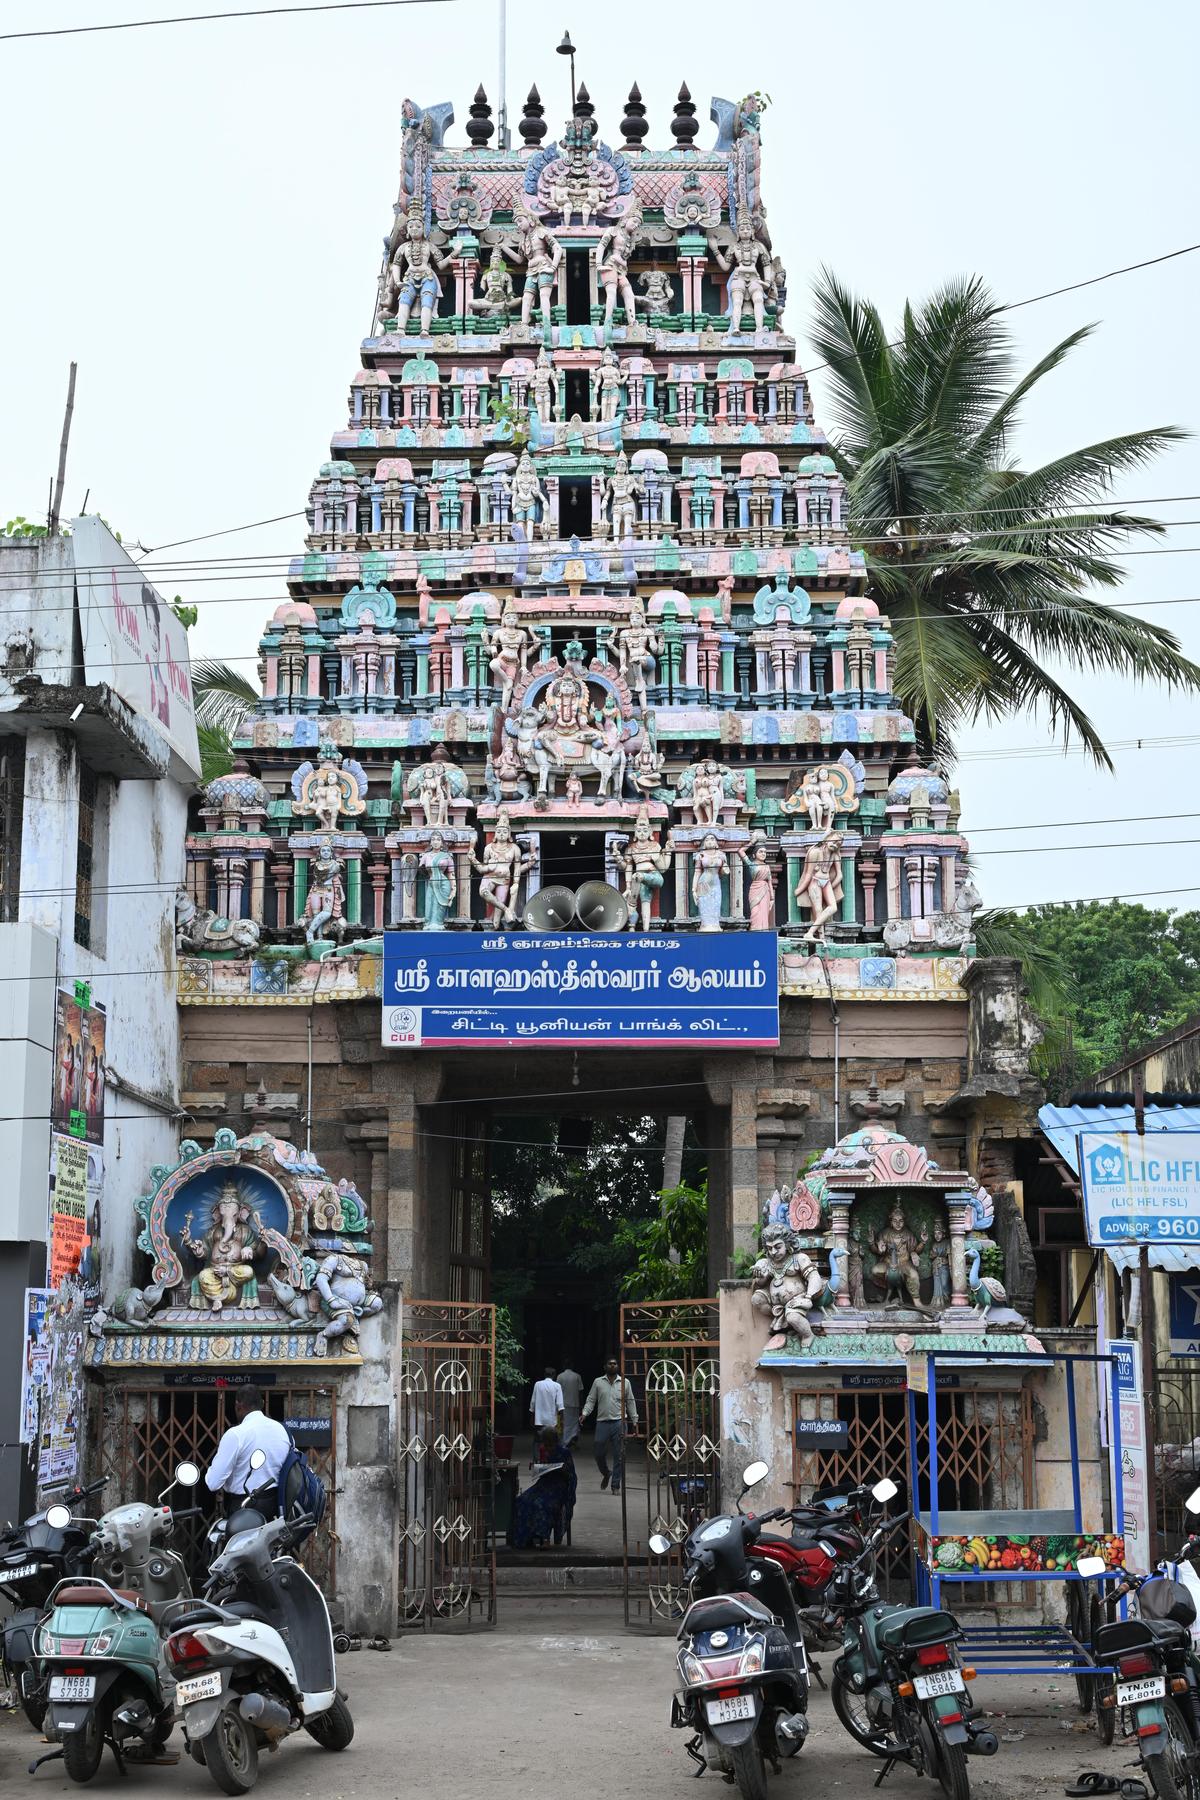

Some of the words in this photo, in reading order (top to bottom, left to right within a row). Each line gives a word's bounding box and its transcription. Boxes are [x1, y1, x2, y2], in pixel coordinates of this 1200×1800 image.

[436, 960, 662, 996] காளஹஸ்தீஸ்வரர்
[667, 960, 766, 993] ஆலயம்
[451, 1017, 508, 1034] சிட்டி
[516, 1018, 611, 1035] யூனியன்
[620, 1018, 682, 1031] பாங்க்
[390, 1034, 416, 1042] CUB
[1127, 1160, 1160, 1182] LIC
[1112, 1198, 1134, 1209] (LIC
[1138, 1198, 1160, 1207] HFL
[1162, 1198, 1188, 1209] FSL)
[800, 1421, 842, 1433] கார்த்திகை
[62, 1677, 90, 1687] TN68A
[184, 1677, 214, 1691] TN.68
[923, 1671, 954, 1686] TN68A
[60, 1687, 90, 1698] S7383
[925, 1681, 957, 1697] L5846
[1127, 1680, 1156, 1692] TN.68
[719, 1695, 749, 1709] TN68A
[1120, 1688, 1162, 1703] AE.8016
[719, 1707, 750, 1721] M3343
